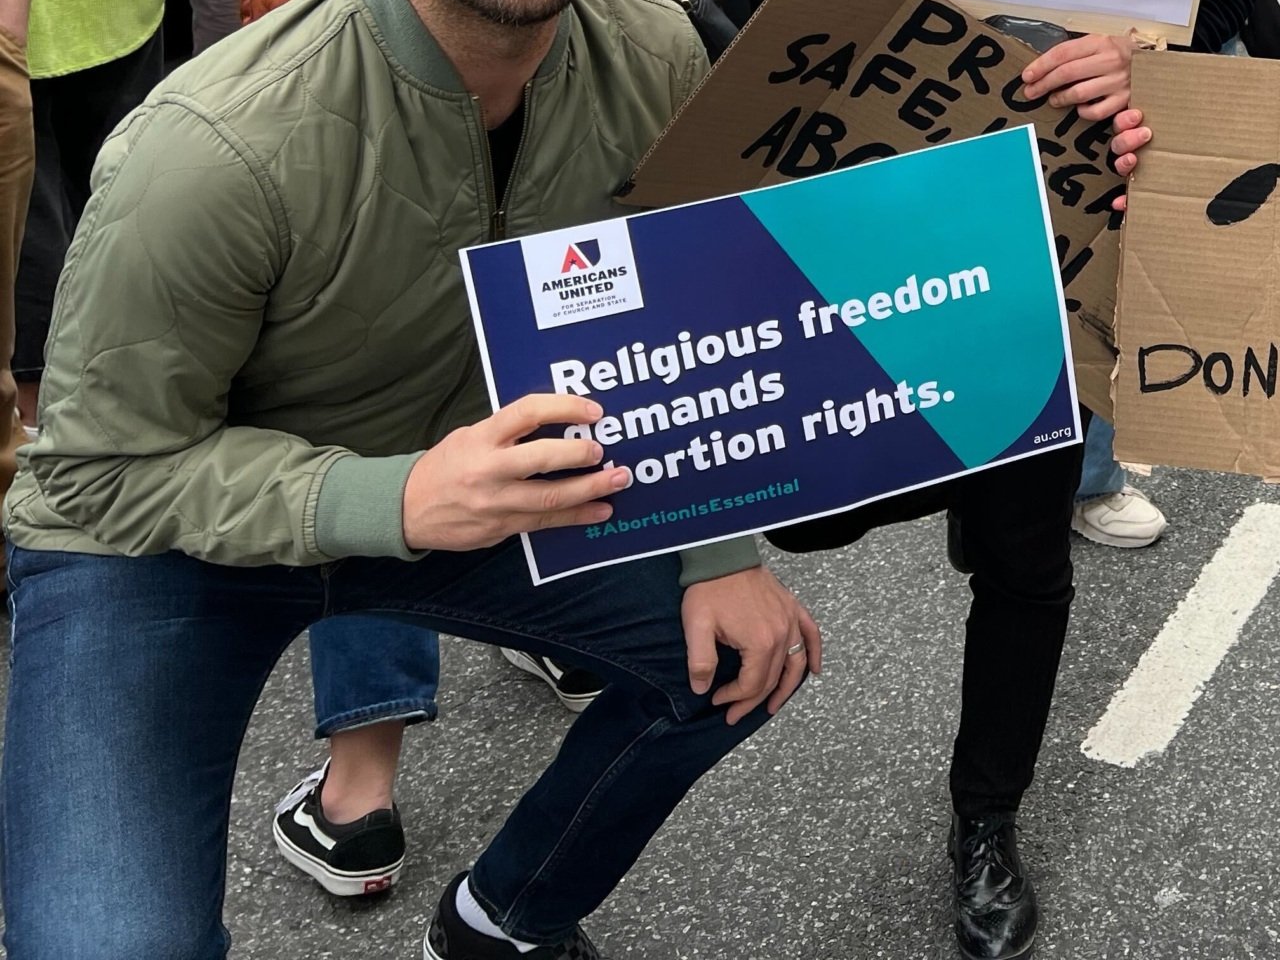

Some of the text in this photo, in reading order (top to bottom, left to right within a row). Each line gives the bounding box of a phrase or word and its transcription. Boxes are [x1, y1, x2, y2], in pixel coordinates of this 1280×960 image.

[542, 266, 628, 293] AMERICANS
[559, 281, 614, 301] UNITED
[561, 295, 617, 311] FOR SEPARATION
[563, 306, 590, 315] CHURCH
[592, 302, 605, 310] AND
[608, 298, 627, 307] STATE
[550, 319, 783, 396] Religious
[798, 266, 990, 338] freedom
[603, 380, 955, 490] ortion rights.
[1033, 427, 1072, 444] au.org
[585, 478, 800, 539] #AbortionIsEssential
